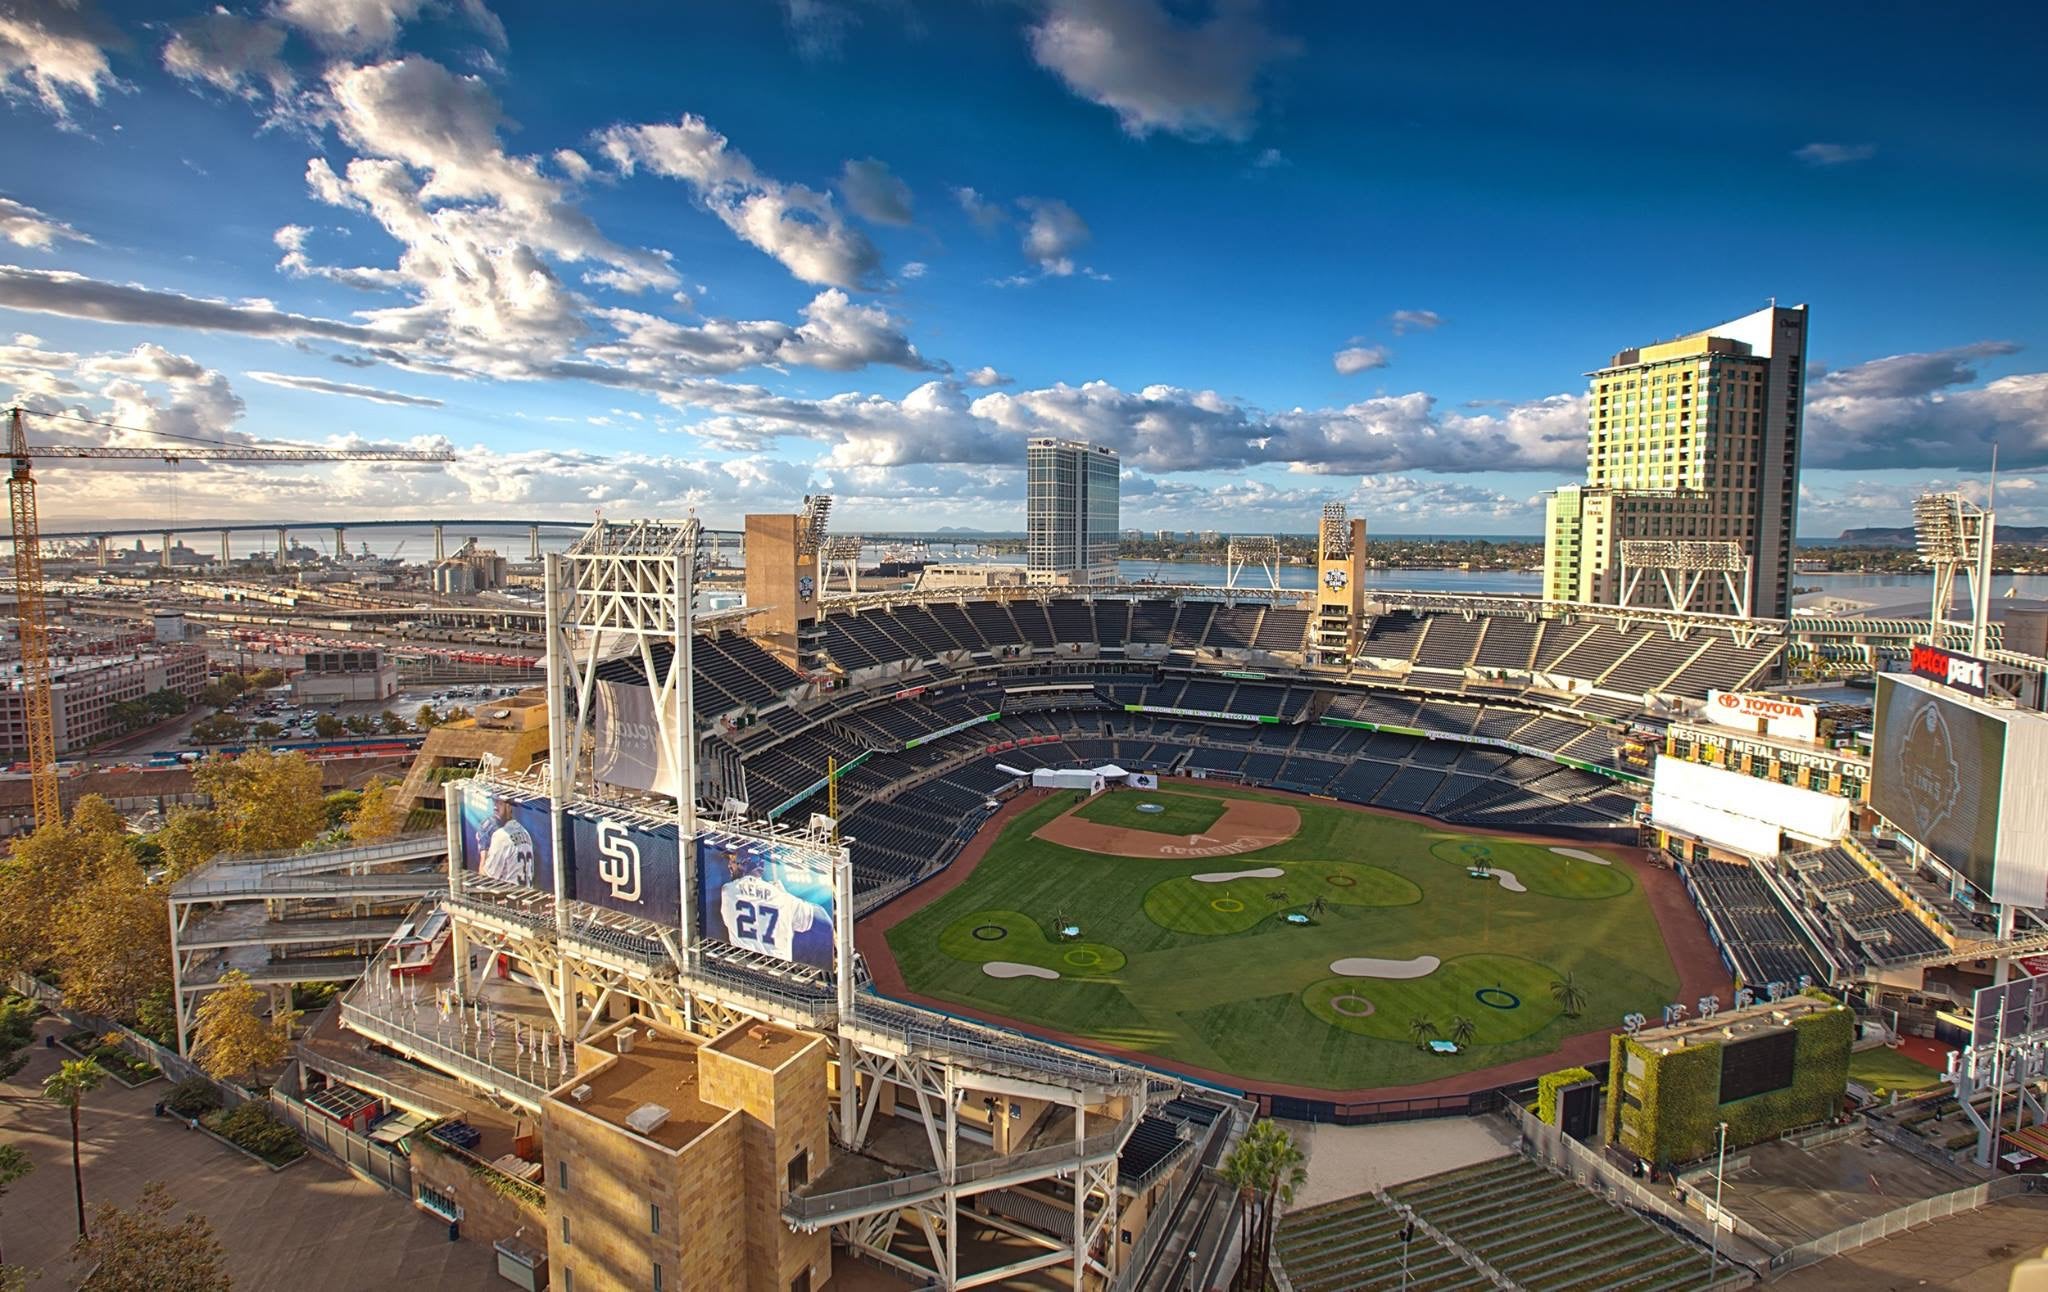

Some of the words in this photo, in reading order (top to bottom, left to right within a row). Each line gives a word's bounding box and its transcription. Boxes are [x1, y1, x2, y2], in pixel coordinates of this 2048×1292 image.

[1911, 645, 1948, 676] petco
[1947, 657, 1984, 689] park
[1142, 705, 1172, 714] WELCOME
[1223, 712, 1242, 720] PETCO
[1744, 698, 1804, 718] TOYOTA
[1670, 727, 1727, 749] WESTERN
[1732, 740, 1776, 760] METAL
[1779, 750, 1837, 772] SUPPLY
[1842, 763, 1870, 780] CO.
[738, 883, 772, 900] KEMP
[736, 900, 779, 945] 27
